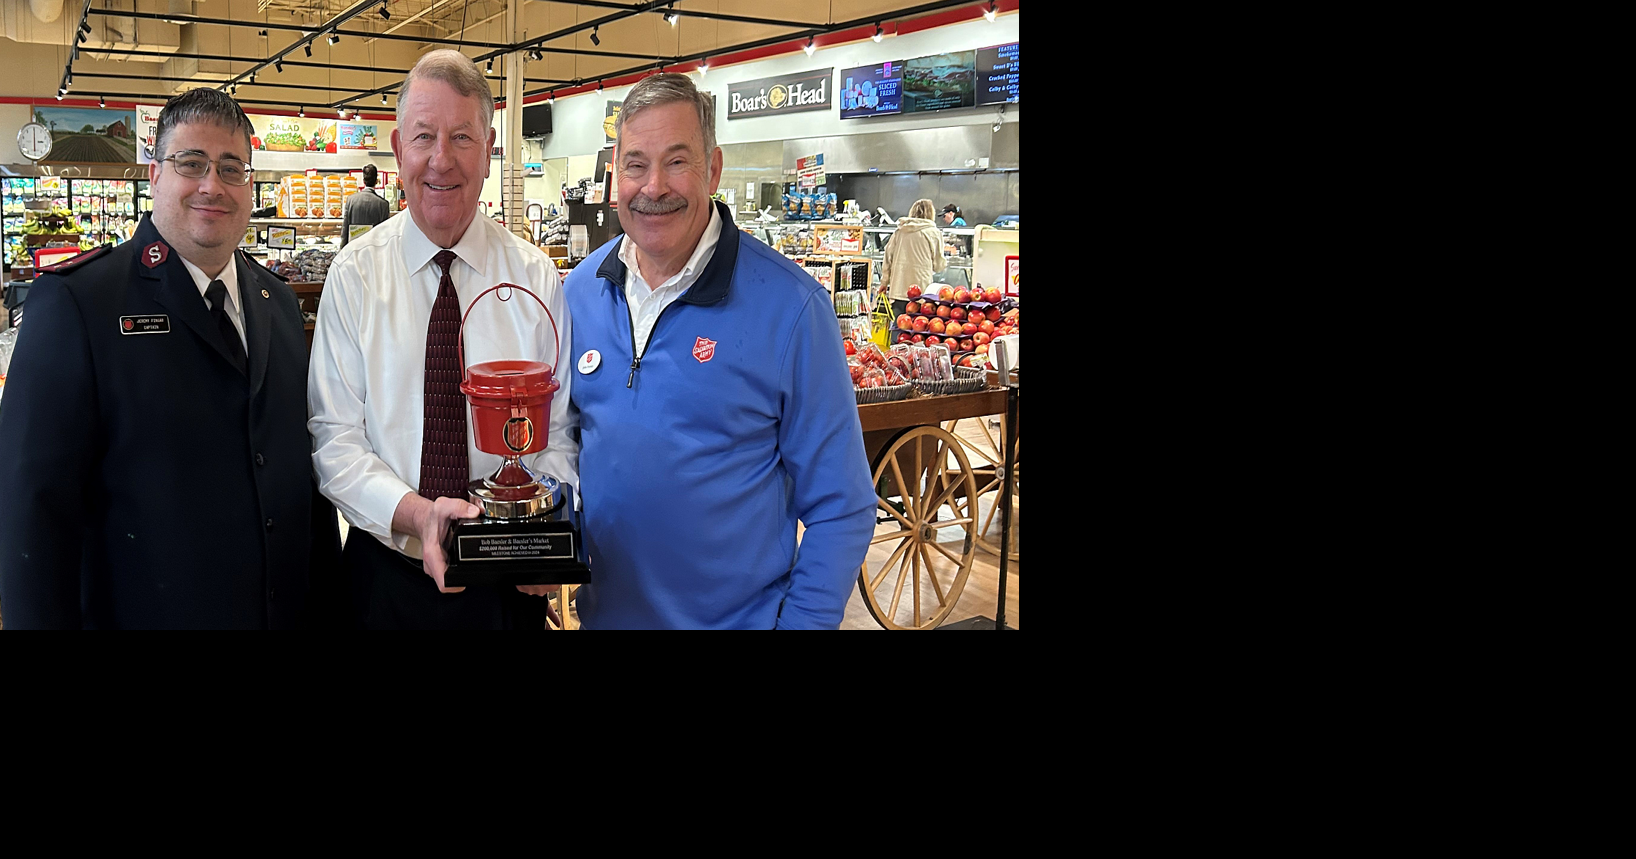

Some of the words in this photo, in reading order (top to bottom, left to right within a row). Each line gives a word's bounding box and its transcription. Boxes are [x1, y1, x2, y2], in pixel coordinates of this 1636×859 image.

[732, 88, 767, 113] Boar's
[787, 78, 826, 106] Head
[270, 123, 300, 132] SALAD
[149, 245, 162, 264] S
